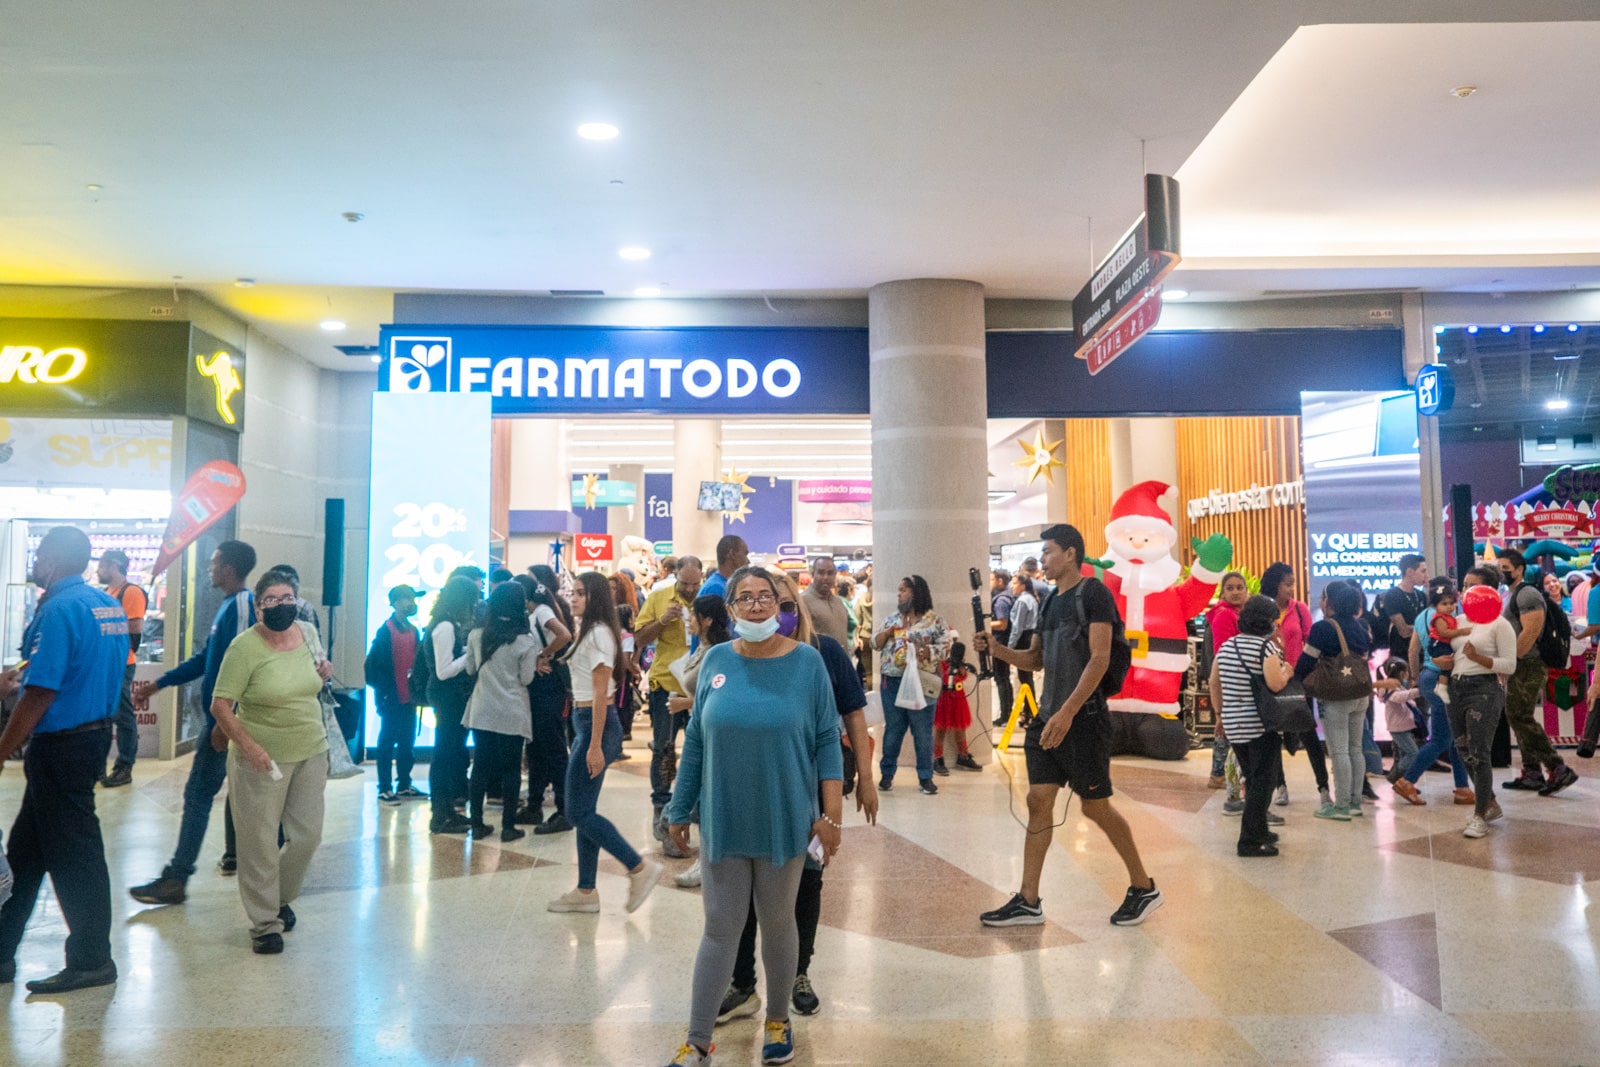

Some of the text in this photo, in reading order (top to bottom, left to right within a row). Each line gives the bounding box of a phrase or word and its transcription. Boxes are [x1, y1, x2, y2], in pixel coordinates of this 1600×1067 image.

[1115, 243, 1134, 271] BELLO
[1115, 258, 1150, 304] PLAZA OESTE
[0, 345, 87, 384] RO
[459, 357, 802, 399] FARMATODO
[1551, 512, 1578, 522] CHRISTMAS
[581, 537, 607, 549] Colgate
[1311, 533, 1418, 552] Y QUE BIEN
[1312, 552, 1339, 564] QUE
[1313, 566, 1330, 577] LA
[1330, 566, 1389, 577] MEDICINA
